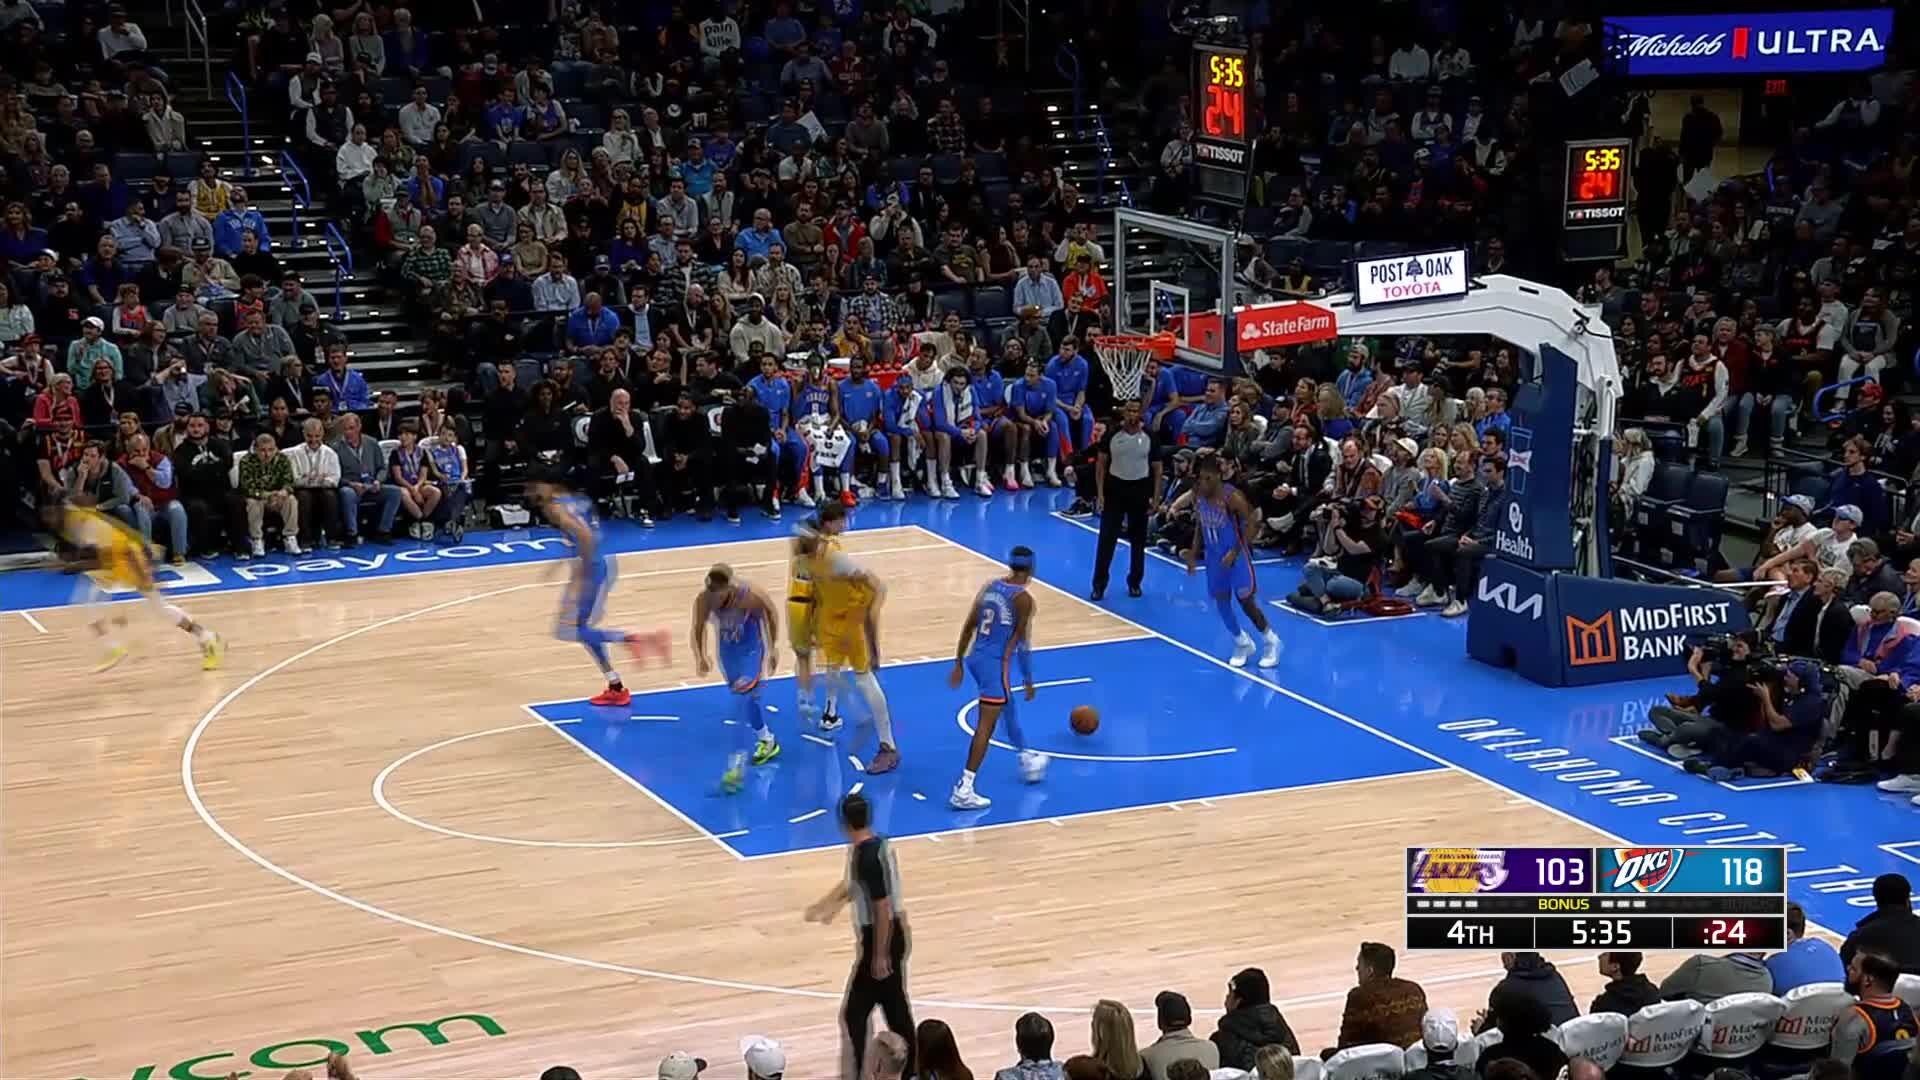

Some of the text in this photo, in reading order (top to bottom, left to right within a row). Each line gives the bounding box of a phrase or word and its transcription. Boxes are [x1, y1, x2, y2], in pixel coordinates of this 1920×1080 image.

[704, 23, 733, 38] pain
[1620, 32, 1727, 56] Michelob
[1210, 55, 1244, 88] 5:35
[1206, 84, 1243, 136] 24
[1585, 148, 1620, 171] 5:35
[1580, 171, 1612, 199] 24
[1371, 255, 1453, 285] POST OAK
[1383, 280, 1441, 300] TOYOTA
[232, 537, 574, 580] paycom
[1495, 530, 1533, 561] Health
[980, 608, 995, 636] 2
[1437, 718, 1679, 807] OKLAHOMA
